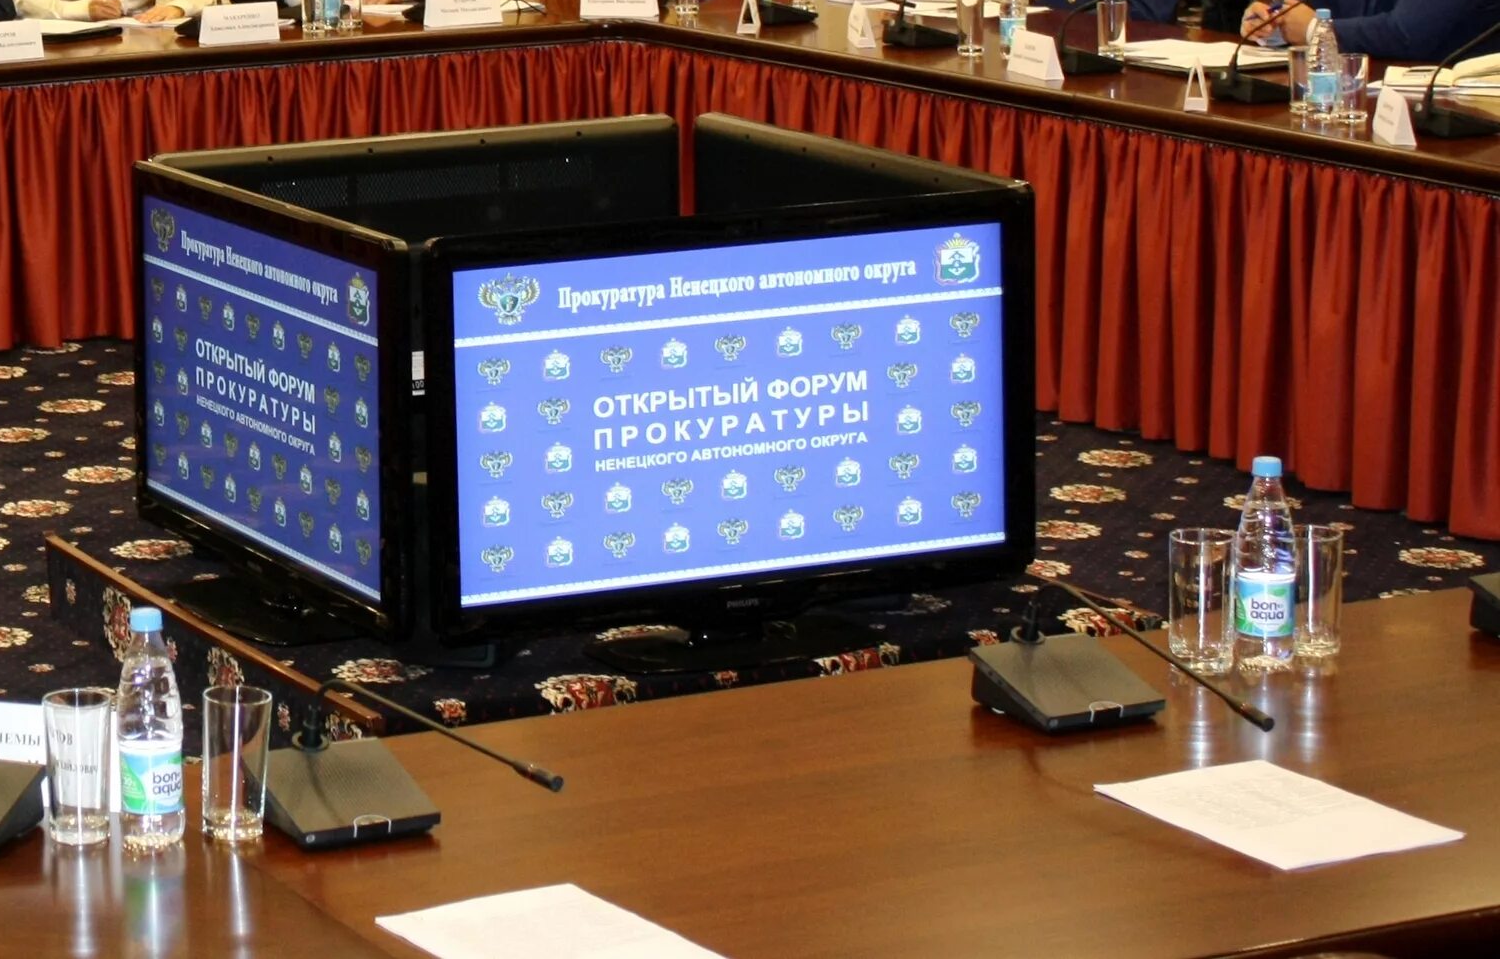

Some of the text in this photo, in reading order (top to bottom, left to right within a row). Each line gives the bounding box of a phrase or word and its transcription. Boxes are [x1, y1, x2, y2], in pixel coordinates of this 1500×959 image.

[181, 230, 338, 305] Прокуратура Ненецкого автономного округа
[558, 260, 916, 313] Прокуратура Ненецкого автономного округа
[195, 338, 316, 404] ОТКРЫТЫЙ ФОРУМ
[593, 370, 868, 418] ОТКРЫТЫЙ ФОРУМ
[196, 366, 316, 435] ПРОКУРАТУРЫ
[196, 395, 316, 456] НЕНЕЦКОГО АВТОНОМНОГО ОКРУГА
[594, 401, 869, 450] ПРОКУРАТУРЫ
[595, 431, 869, 472] НЕНЕЦКОГО АВТОНОМНОГО ОКРУГА
[1250, 610, 1284, 622] aqua
[1251, 597, 1277, 610] bon
